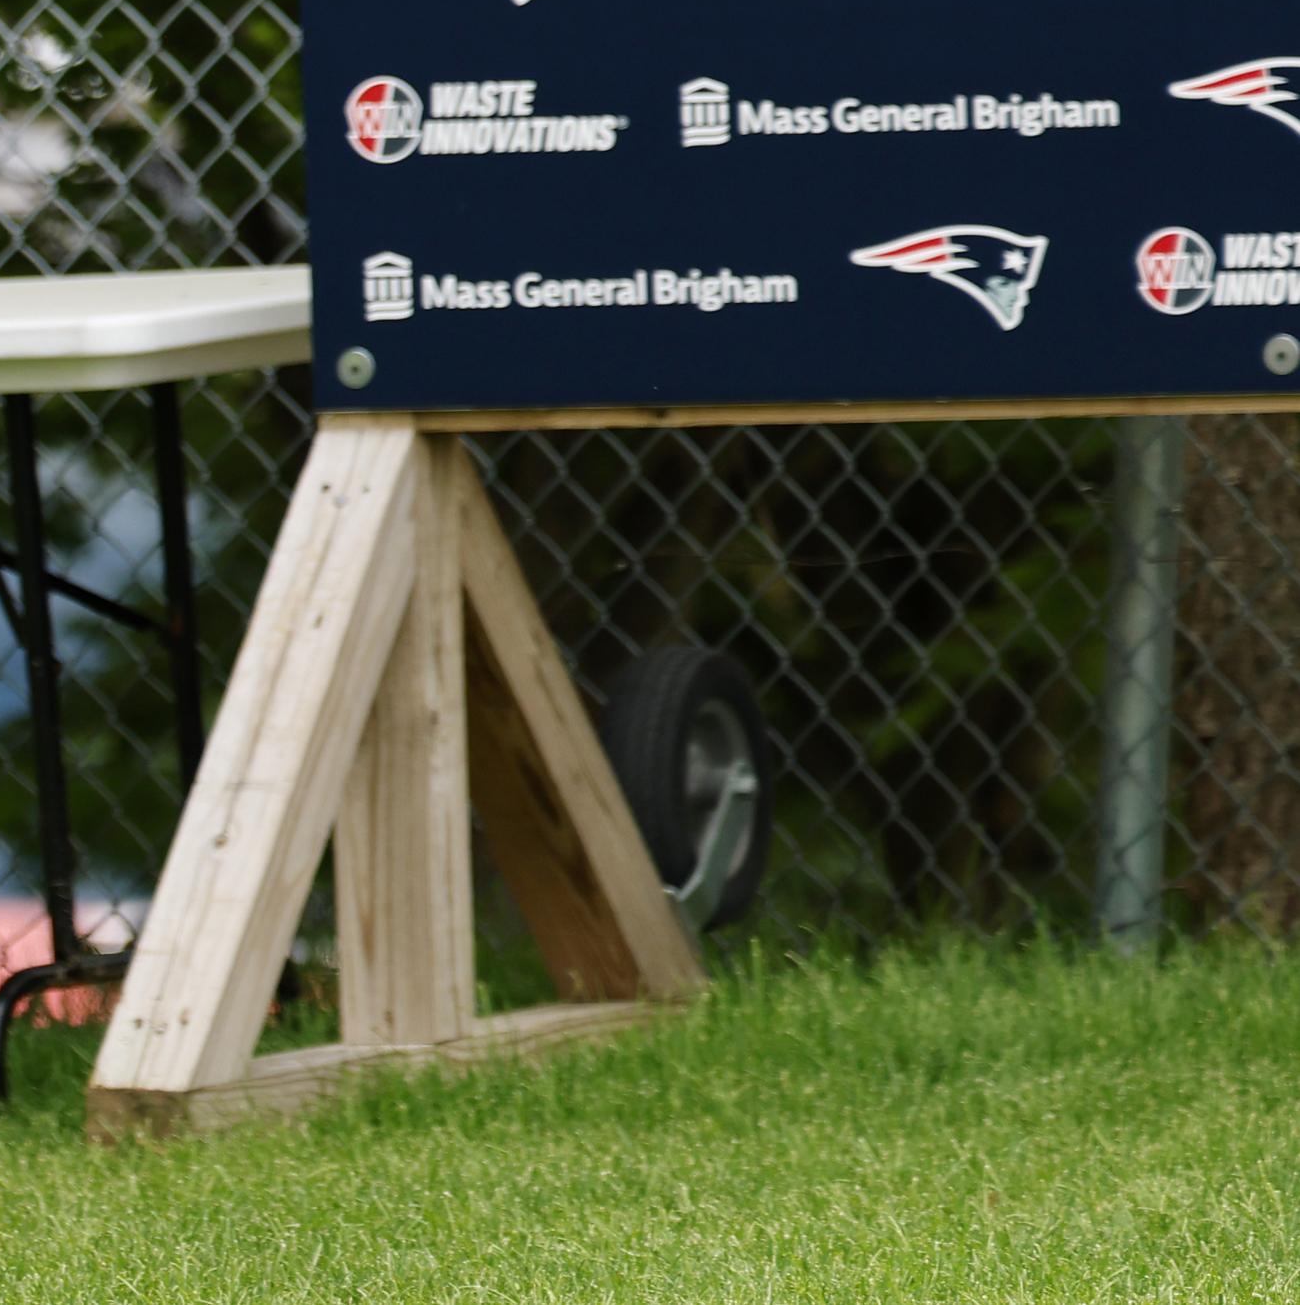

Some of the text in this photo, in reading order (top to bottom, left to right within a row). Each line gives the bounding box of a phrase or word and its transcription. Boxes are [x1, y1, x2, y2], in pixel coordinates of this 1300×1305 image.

[430, 81, 536, 118] WASTE
[738, 94, 1119, 136] Mass General Brigham
[421, 269, 797, 311] Mass General Brigham
